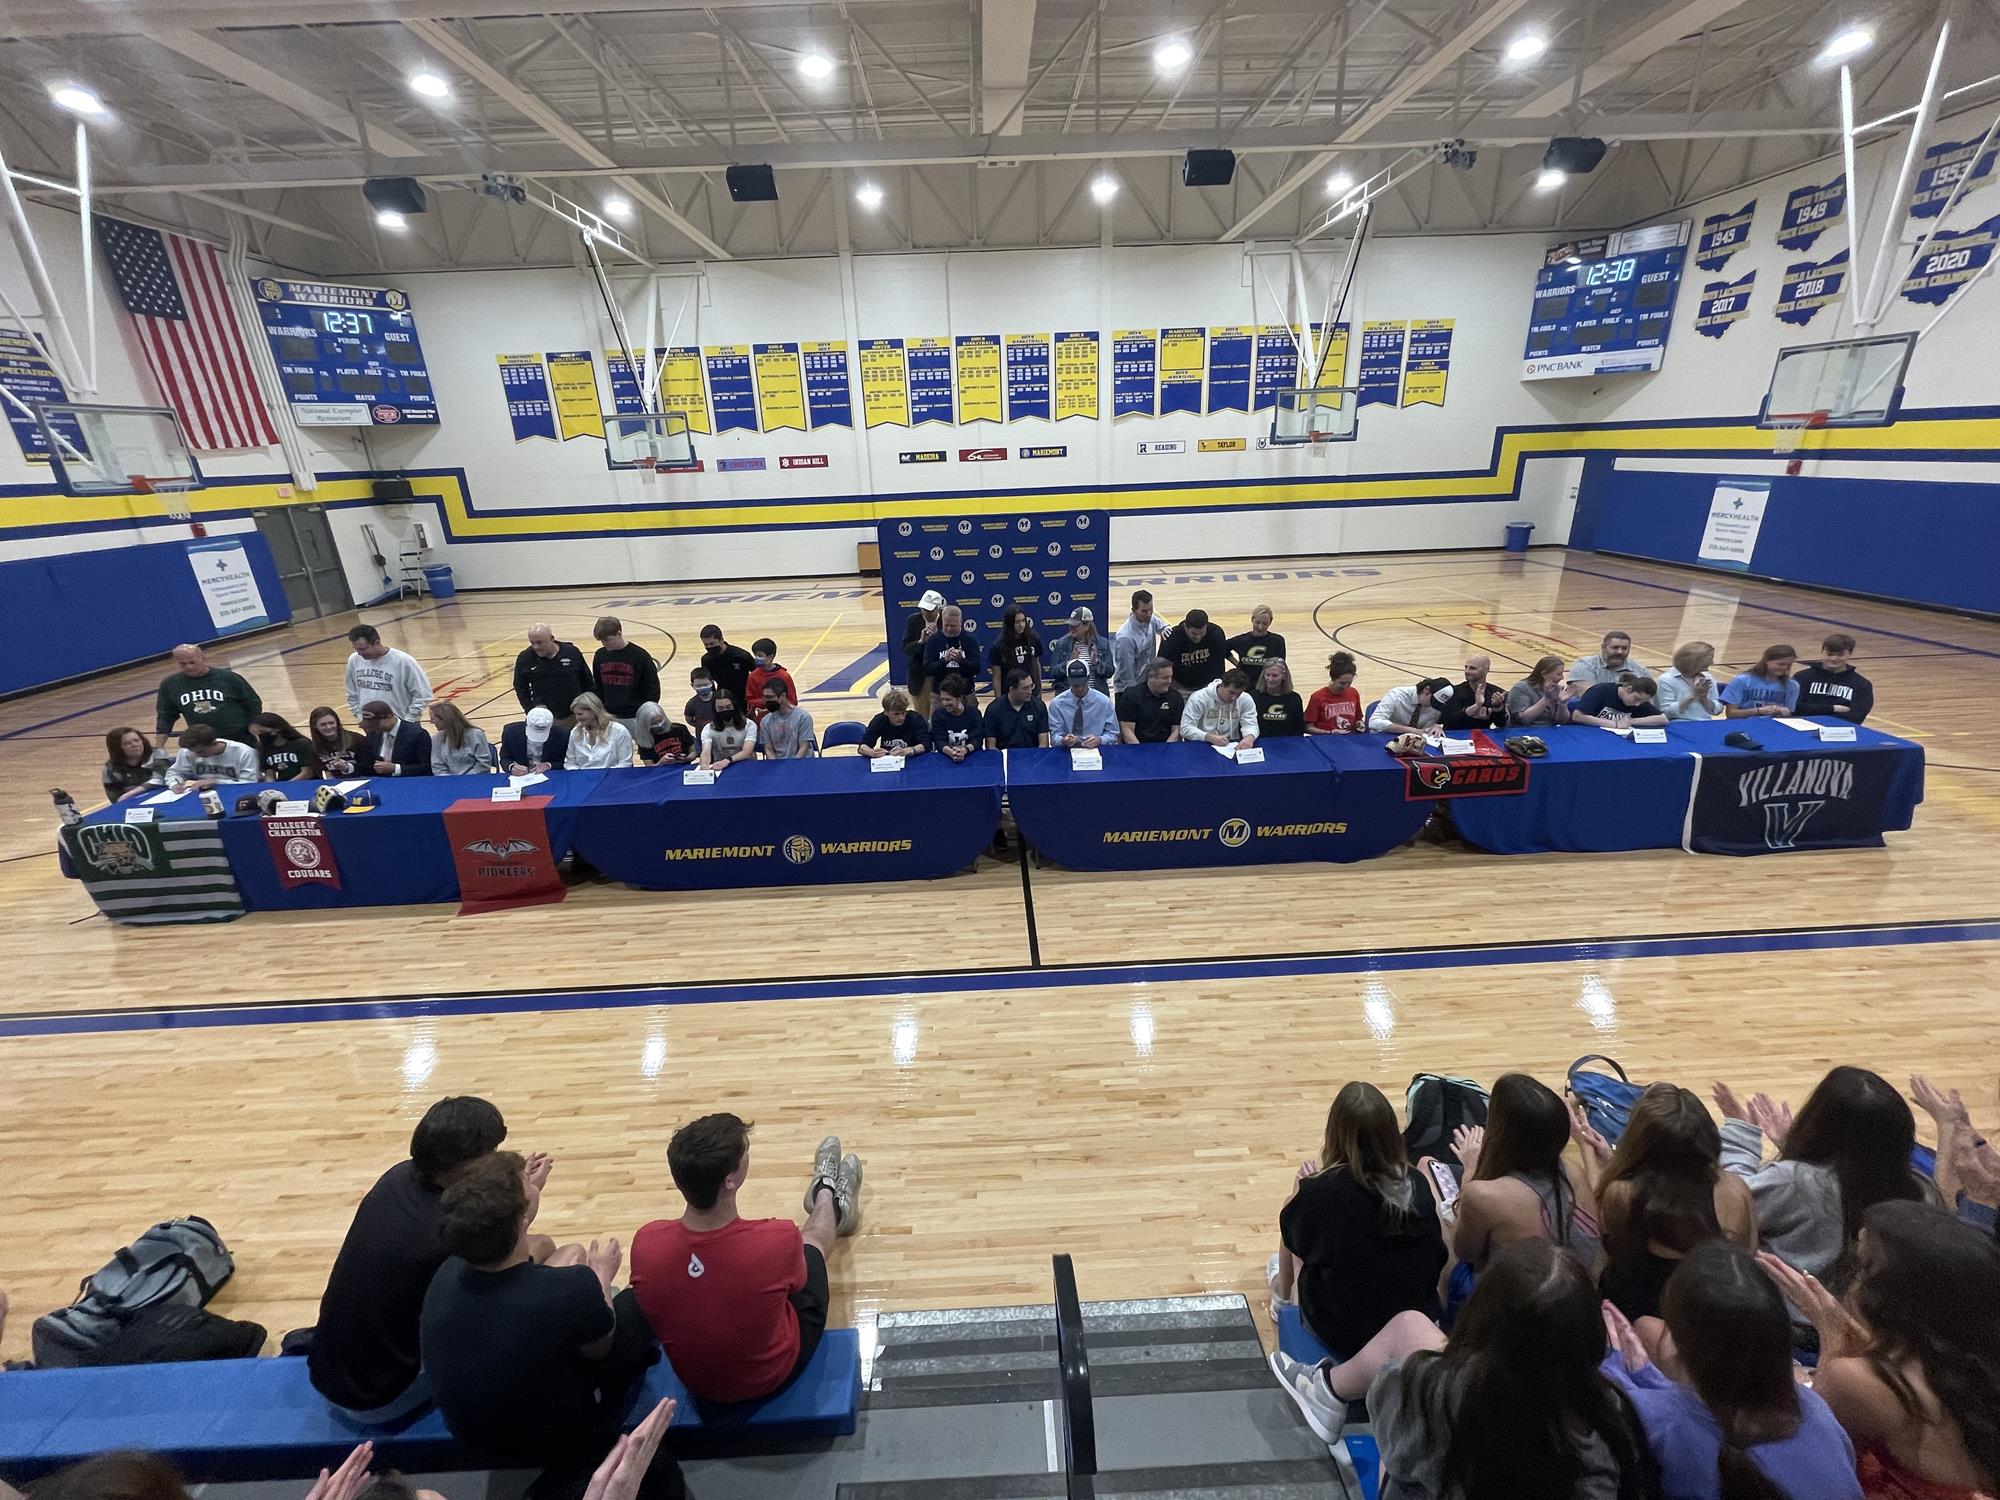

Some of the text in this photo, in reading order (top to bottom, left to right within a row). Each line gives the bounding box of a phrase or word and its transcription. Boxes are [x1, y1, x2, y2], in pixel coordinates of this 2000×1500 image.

[1796, 202, 1828, 225] 1949
[1925, 250, 1971, 274] 2020
[1586, 258, 1636, 286] 12:38
[1641, 271, 1670, 284] GUEST
[289, 284, 379, 299] MARIEMONT
[1535, 285, 1576, 299] WARRIORS
[1795, 279, 1825, 298] 2018
[294, 293, 374, 306] WARRIORS
[1711, 297, 1735, 314] 2017
[322, 311, 373, 334] 12:37
[267, 326, 318, 338] WARRIORS
[384, 332, 411, 343] GUEST
[1032, 448, 1064, 456] MARIEMONT
[1154, 443, 1177, 451] READING
[792, 457, 825, 466] INDIAN HILL
[915, 453, 940, 461] MADEIRA
[1109, 568, 1382, 587] ARRIORS
[1241, 656, 1266, 665] CENTR
[356, 668, 393, 682] COLLEGE OF
[180, 689, 224, 706] OHIO
[1262, 712, 1288, 720] CENTRE
[267, 752, 299, 767] OHIO
[195, 763, 237, 782] OHIO
[1451, 766, 1520, 785] CARDS
[1738, 758, 1855, 807] VILLANOVA
[268, 821, 316, 830] COLLEGE OF
[268, 829, 322, 837] CHARLESTON
[1103, 828, 1213, 844] MARIEMONT
[1256, 822, 1348, 837] WARRIORS
[665, 839, 912, 861] MARIEMONT WARRIORS
[287, 869, 332, 878] COUGARS
[477, 867, 534, 878] PIONEERS
